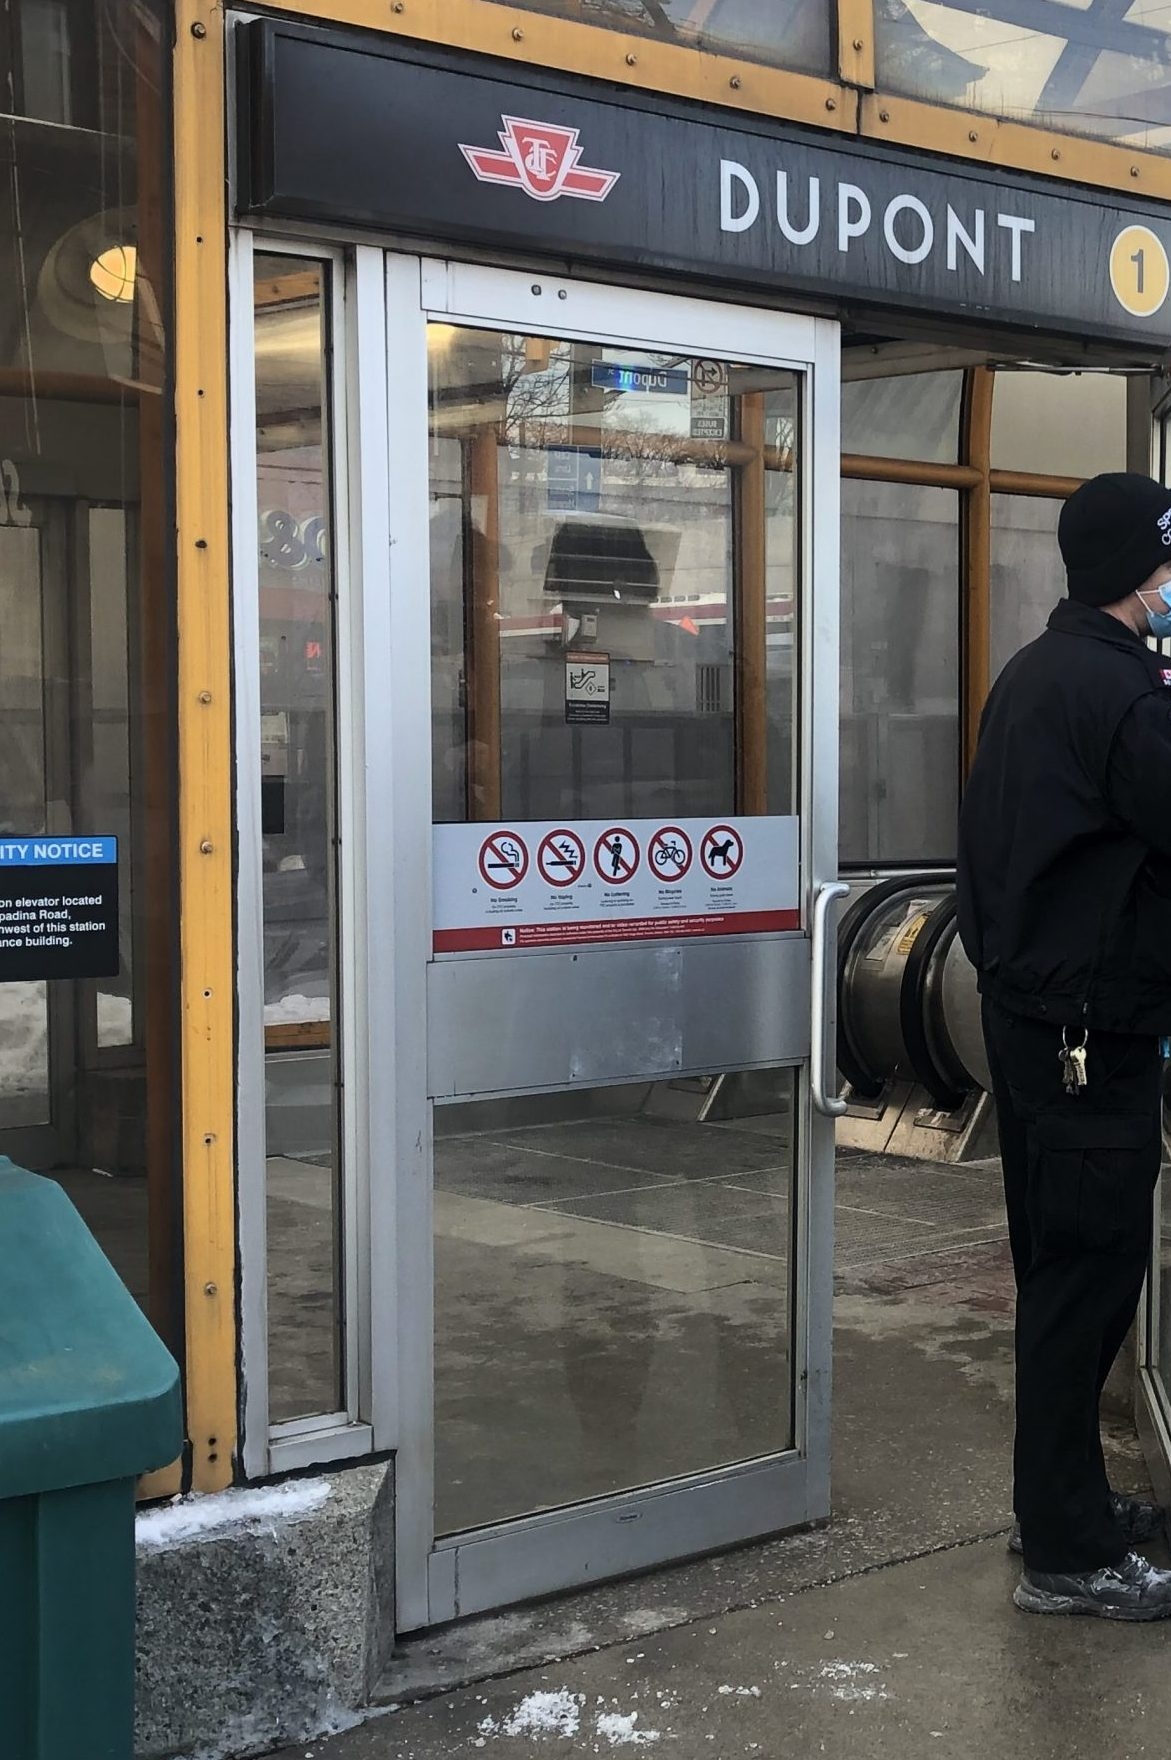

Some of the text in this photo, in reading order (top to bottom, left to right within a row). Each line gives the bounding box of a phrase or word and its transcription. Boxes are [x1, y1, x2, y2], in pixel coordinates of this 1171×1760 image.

[720, 159, 1035, 281] DUPONT
[1130, 248, 1145, 294] 1
[0, 843, 104, 860] ITY NOTICE
[15, 897, 60, 907] elevator
[62, 895, 103, 906] located
[0, 909, 72, 923] padina Road,
[32, 923, 44, 933] of
[46, 922, 67, 932] this
[69, 921, 106, 932] station
[0, 935, 73, 948] nce building.
